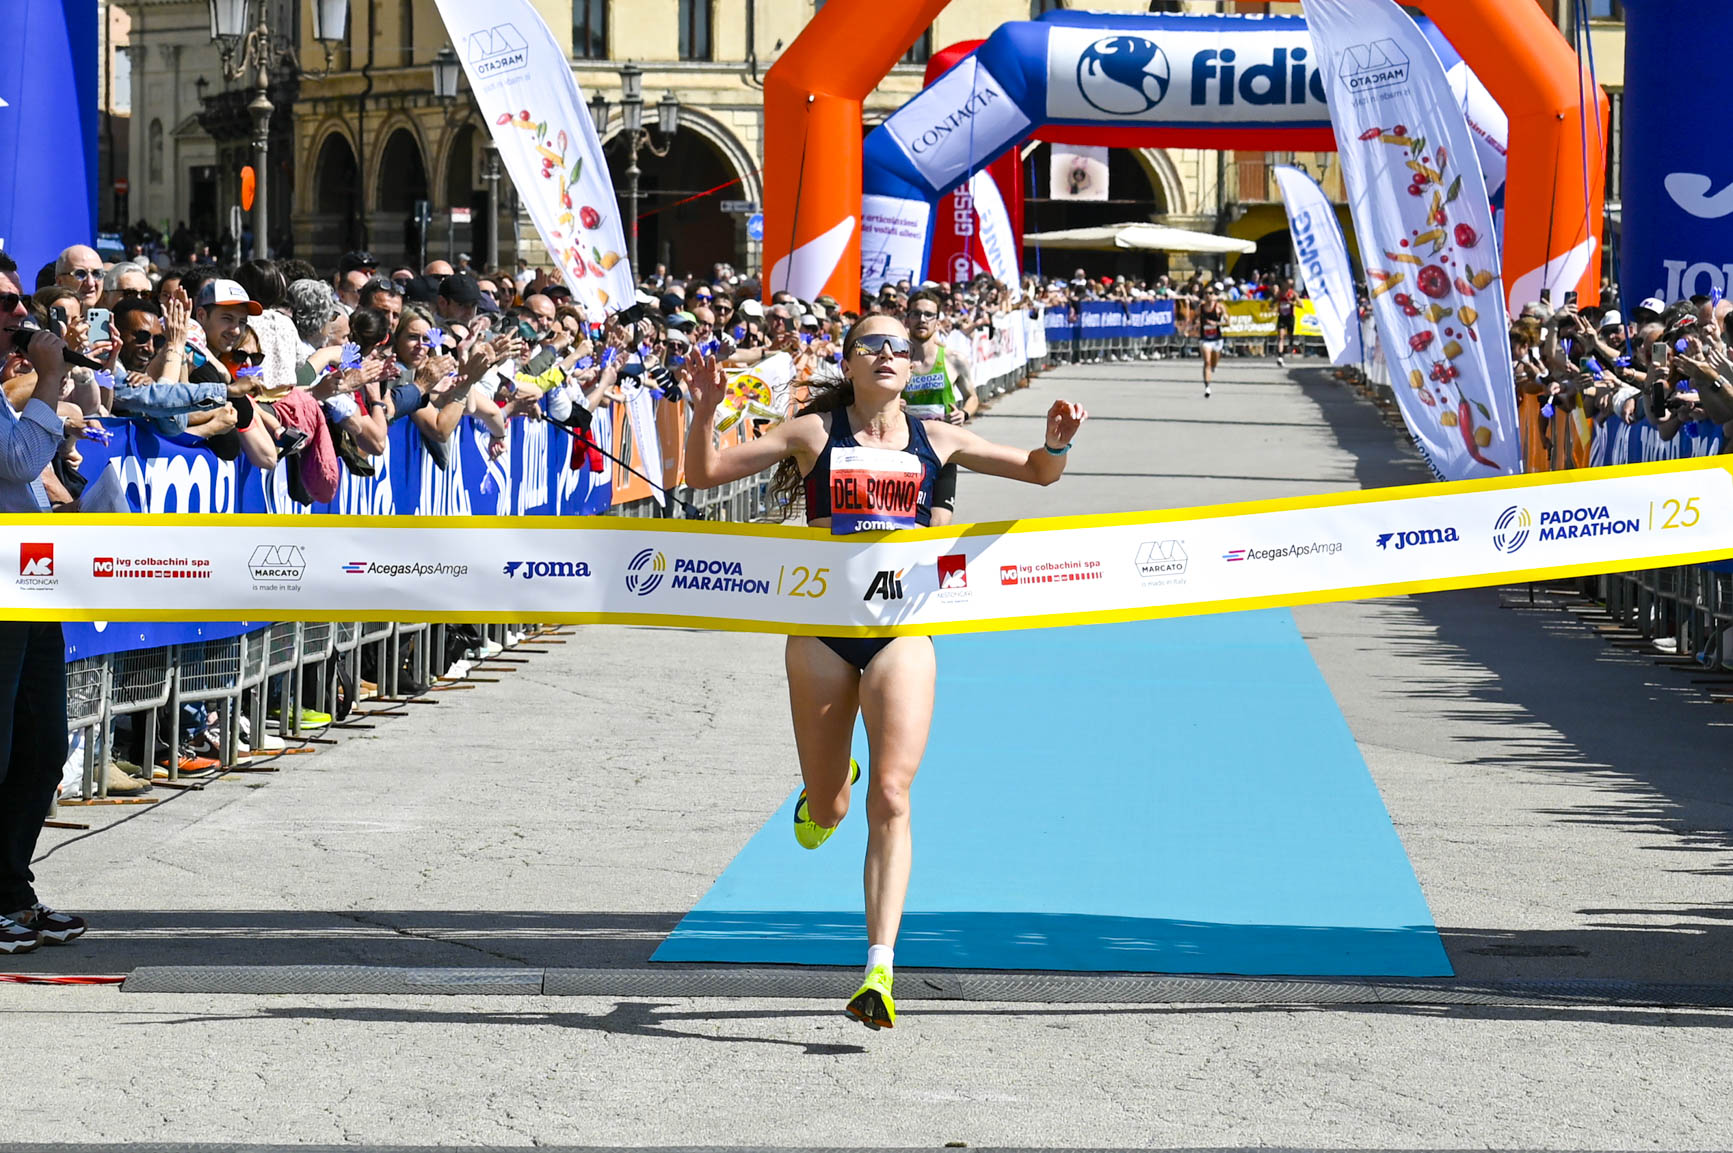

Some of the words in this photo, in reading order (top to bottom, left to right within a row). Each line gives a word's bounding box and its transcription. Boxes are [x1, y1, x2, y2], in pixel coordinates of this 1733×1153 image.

[911, 88, 998, 154] CONTACTA
[1655, 259, 1733, 306] JO
[912, 373, 943, 384] icenza
[834, 478, 862, 509] DEL
[867, 478, 916, 512] BUONO
[1540, 506, 1610, 525] PADOVA
[1661, 497, 1701, 530] 25
[1539, 519, 1640, 542] MARATHON
[1247, 542, 1343, 561] AcegasApsAmga
[116, 557, 131, 567] ivg
[134, 557, 188, 566] colbachini
[191, 559, 210, 567] spa
[367, 562, 468, 577] AcegasApsAmga
[674, 559, 743, 576] PADOVA
[1019, 564, 1033, 573] ivg
[1035, 560, 1082, 572] colbachini
[1084, 559, 1101, 568] spa
[1142, 563, 1183, 573] MARCATO
[255, 569, 299, 577] MARCATO
[788, 566, 830, 598] 25
[287, 584, 302, 593] Italy
[671, 575, 770, 595] MARATHON
